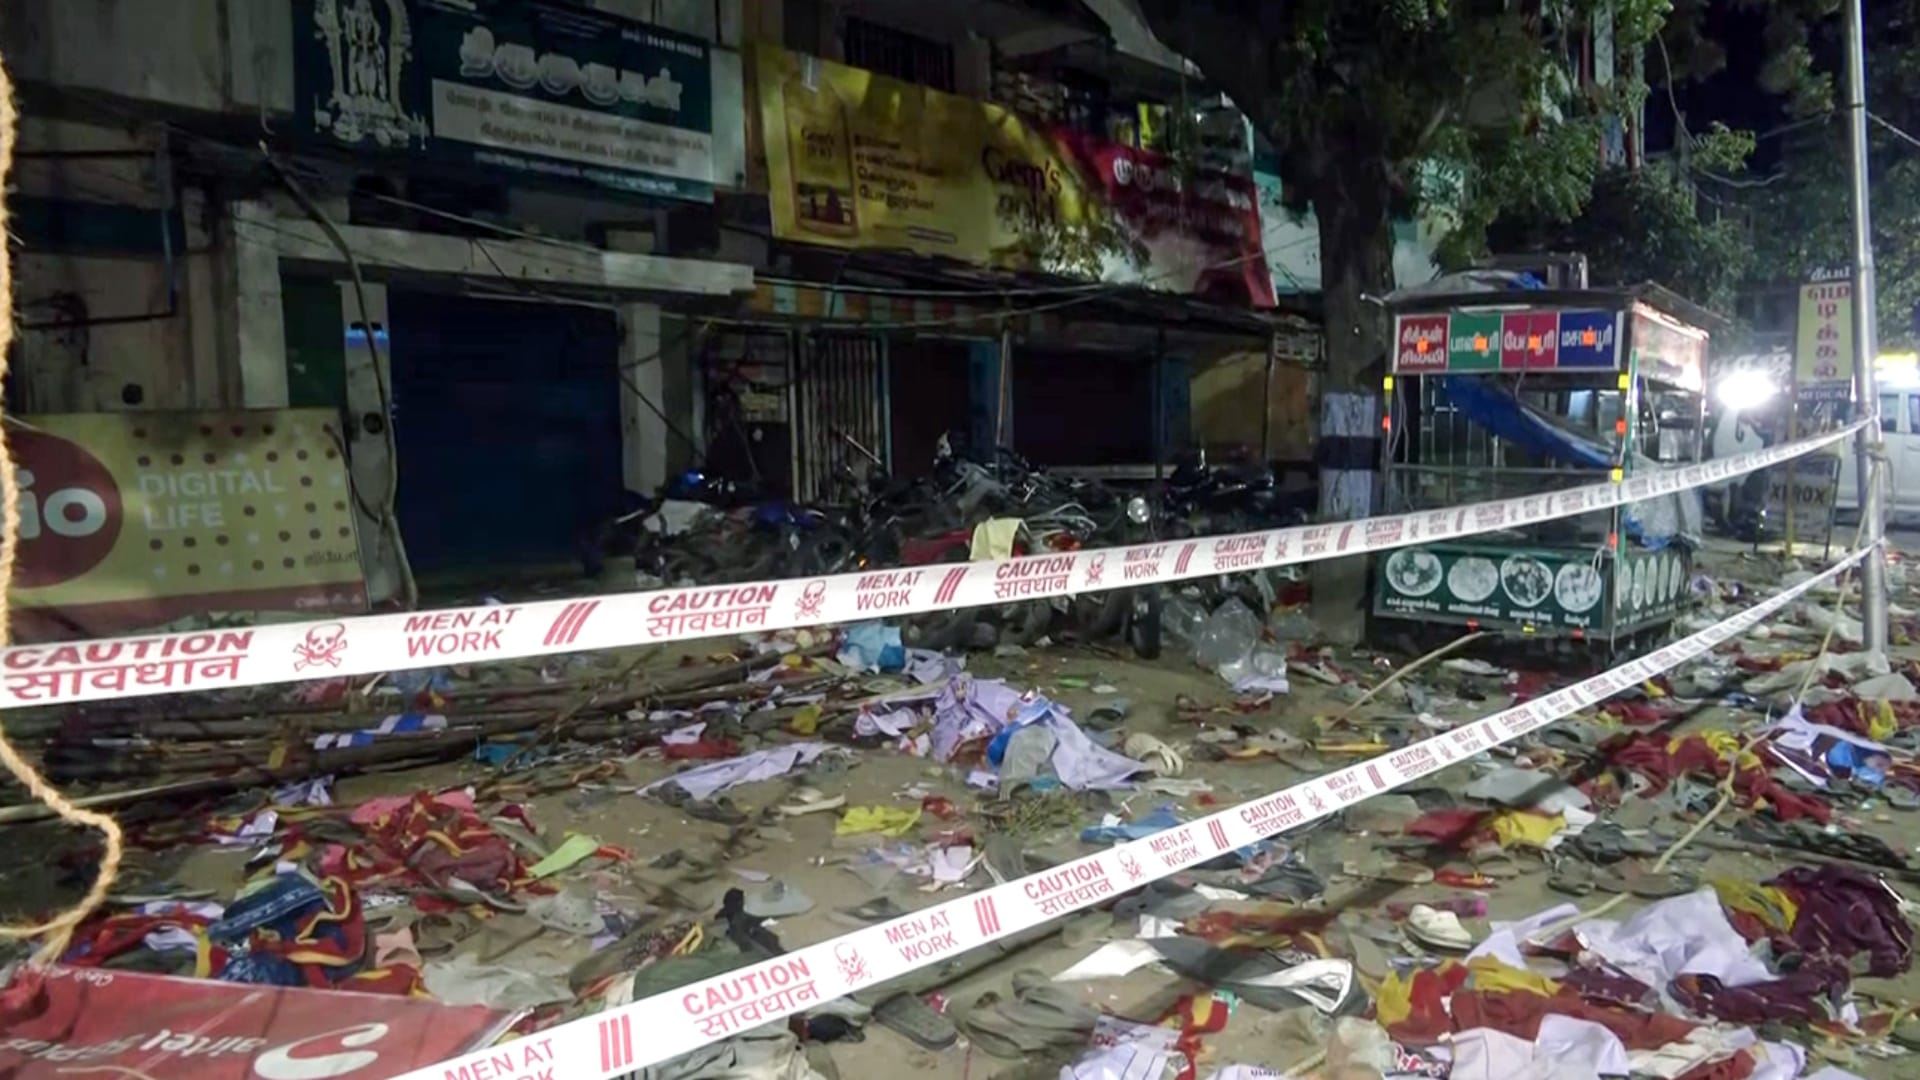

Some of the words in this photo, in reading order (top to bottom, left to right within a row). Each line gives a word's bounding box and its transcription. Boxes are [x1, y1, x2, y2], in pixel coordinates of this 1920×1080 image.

[137, 469, 287, 498] DIGITAL
[16, 468, 107, 540] io
[143, 503, 225, 531] LIFE
[1124, 547, 1151, 562] MEN
[1150, 545, 1167, 558] AT
[1215, 535, 1270, 554] CAUTION
[856, 572, 901, 591] MEN
[898, 570, 925, 587] AT
[995, 556, 1077, 579] CAUTION
[1123, 562, 1159, 579] WORK
[647, 585, 778, 614] CAUTION
[856, 589, 912, 611] WORK
[994, 574, 1071, 599] सावधान
[403, 611, 482, 633] MEN
[477, 607, 523, 627] AT
[645, 604, 772, 637] सावधान
[3, 630, 256, 670] CAUTION
[406, 630, 504, 658] WORK
[2, 654, 250, 700] सावधान
[1389, 747, 1431, 770] CAUTION
[1325, 776, 1346, 791] MEN
[1336, 785, 1367, 803] WORK
[1240, 794, 1296, 824] CAUTION
[1149, 835, 1177, 854] MEN
[1177, 829, 1194, 846] AT
[1162, 845, 1203, 869] WORK
[1024, 859, 1105, 900] CAUTION
[1034, 877, 1115, 916] सावधान
[884, 919, 928, 945] MEN
[928, 909, 952, 932] AT
[898, 931, 959, 963] WORK
[682, 957, 812, 1016] CAUTION
[694, 978, 821, 1040] सावधान
[138, 1028, 268, 1060] airtel
[444, 1053, 514, 1080] MEN
[524, 1038, 555, 1067] AT
